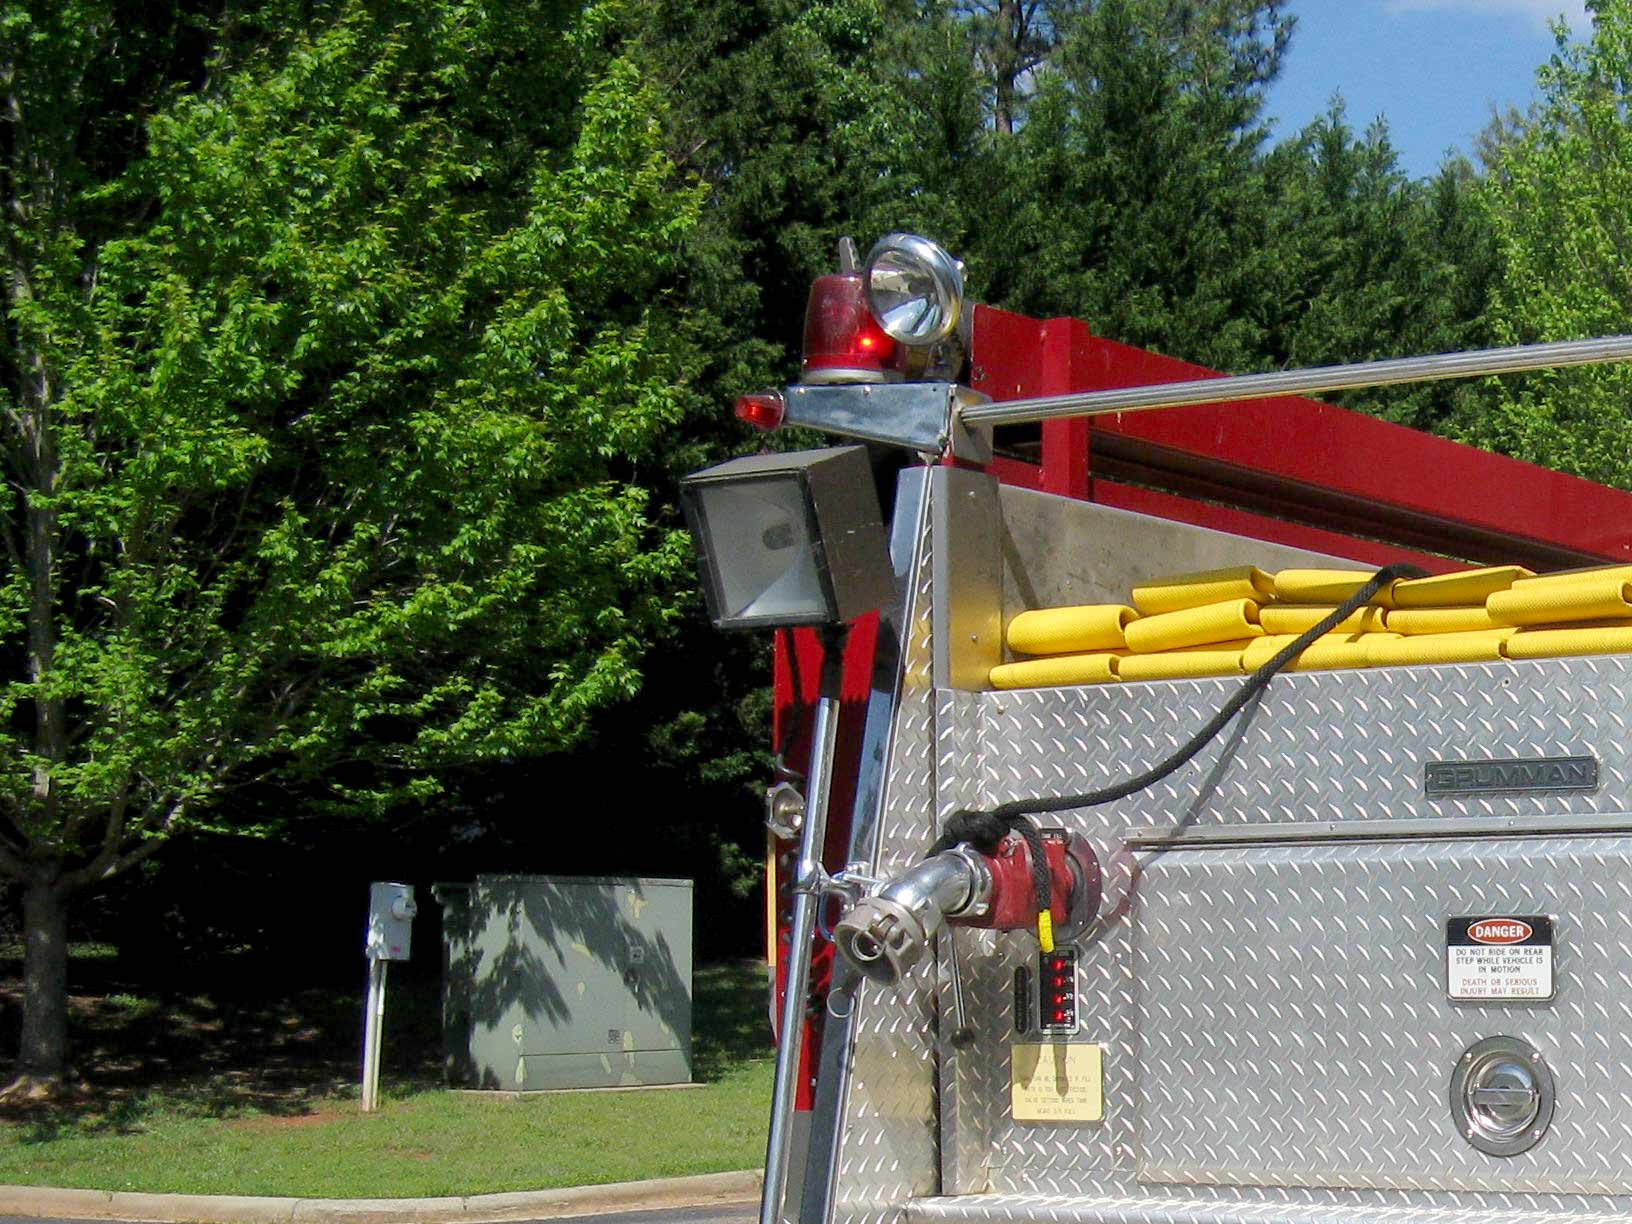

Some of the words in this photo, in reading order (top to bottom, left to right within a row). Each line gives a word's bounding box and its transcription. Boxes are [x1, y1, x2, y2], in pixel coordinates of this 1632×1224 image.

[1436, 763, 1588, 785] GRUMMAN
[1475, 926, 1524, 938] DANGER
[1456, 948, 1466, 956] DO
[1470, 948, 1485, 956] NOT
[1488, 948, 1505, 956] RIDE
[1509, 948, 1520, 956] ON
[1524, 948, 1543, 956] REAR
[1456, 957, 1474, 965] STEP
[1477, 957, 1499, 965] WHILE
[1502, 957, 1533, 965] VEHICLE
[1536, 957, 1543, 965] IS
[1462, 978, 1486, 986] DEATH
[1491, 978, 1500, 986] OR
[1505, 978, 1537, 986] SERIOUS
[1460, 987, 1486, 995] INJURY
[1491, 987, 1507, 995] MAY
[1511, 987, 1539, 995] RESULT
